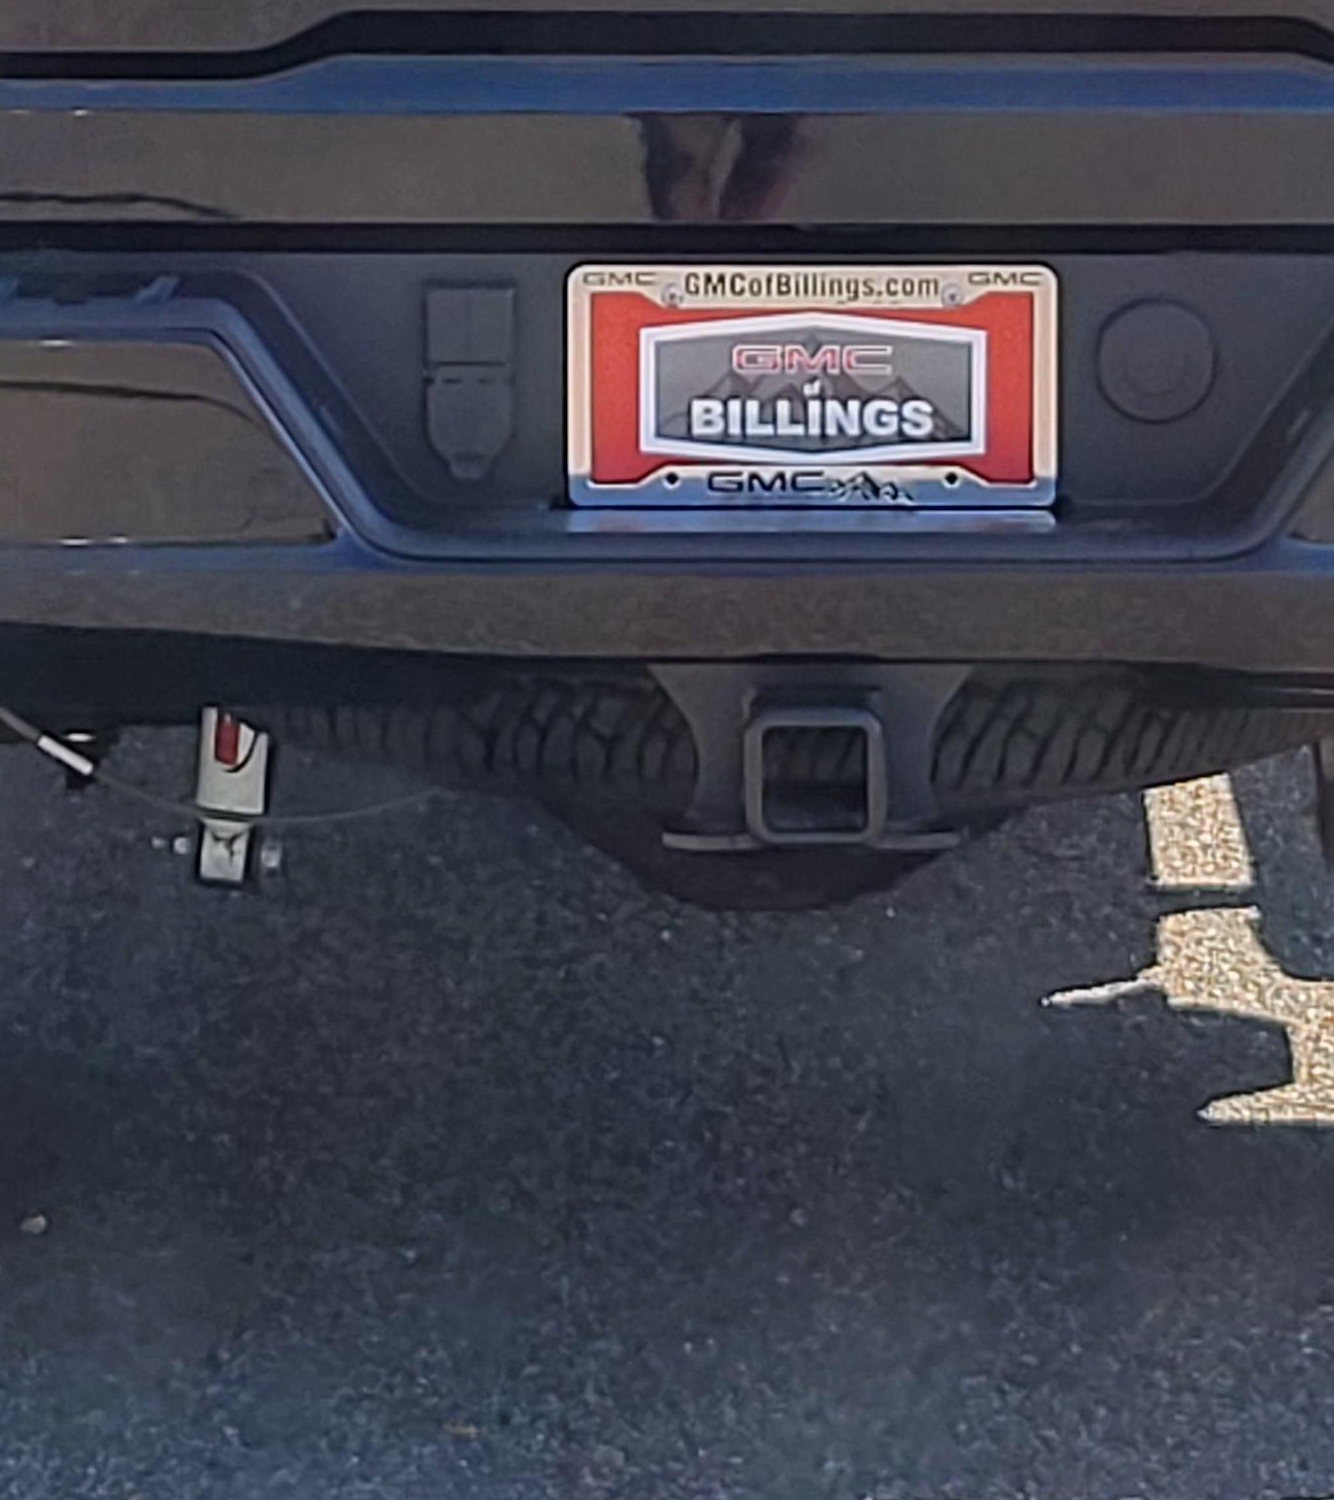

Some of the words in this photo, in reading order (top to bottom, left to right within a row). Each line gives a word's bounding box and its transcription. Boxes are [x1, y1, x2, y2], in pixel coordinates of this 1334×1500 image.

[582, 272, 657, 287] GMC
[684, 272, 940, 303] GMCofBillings.com
[968, 272, 1043, 287] GMC
[731, 344, 894, 375] GMC
[802, 378, 822, 398] of
[689, 398, 934, 438] BILLINGS
[706, 471, 825, 495] GMC
